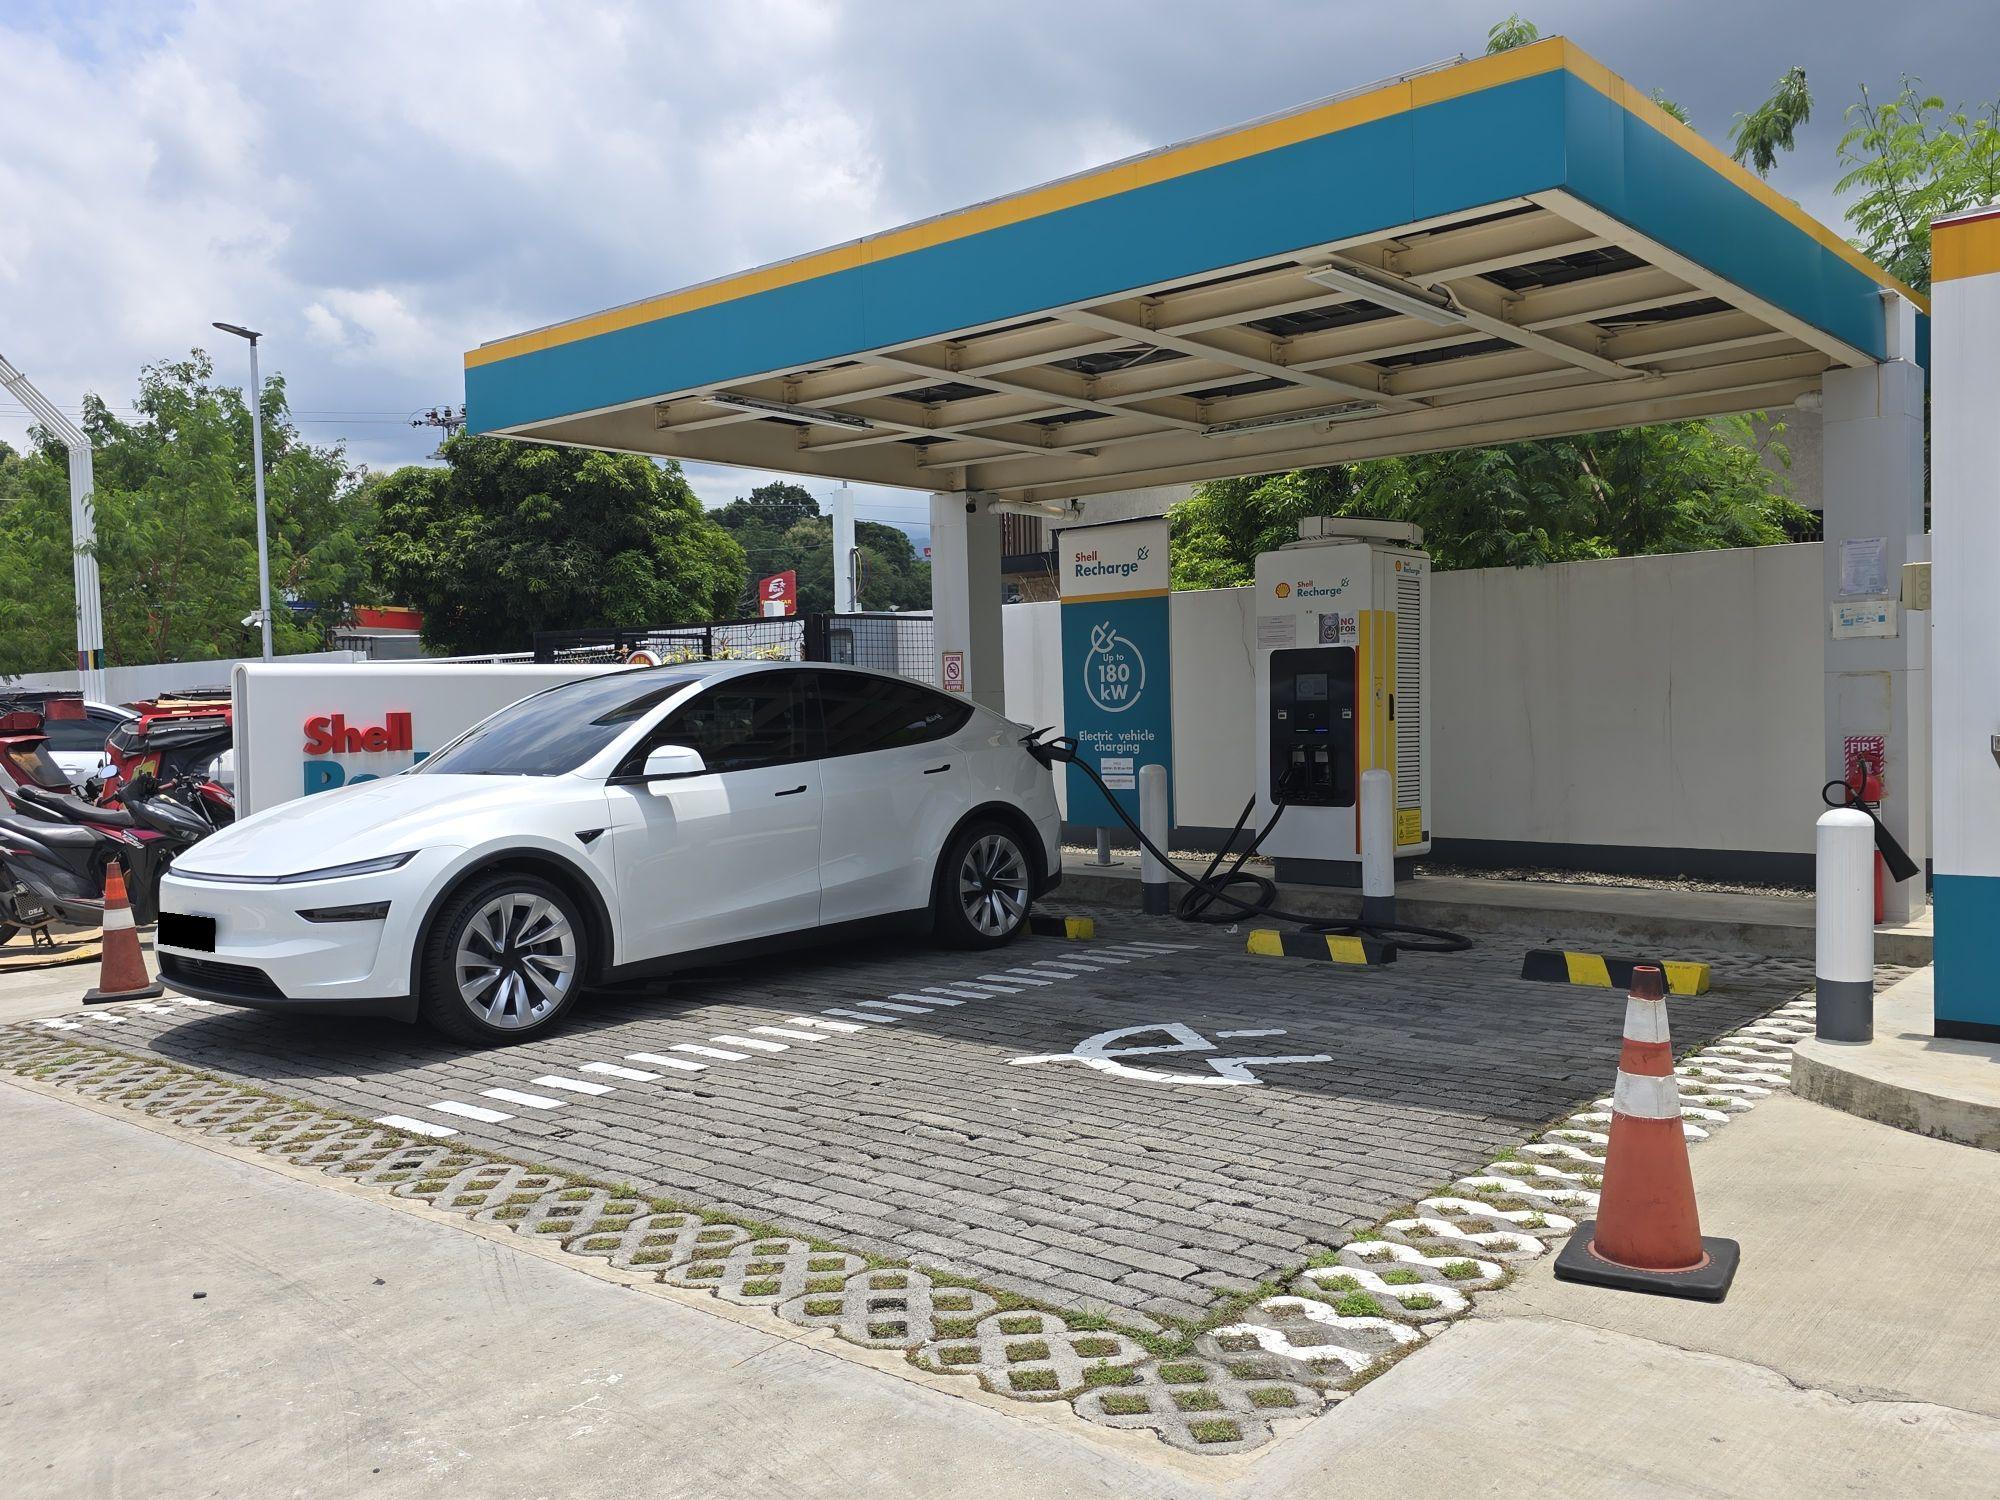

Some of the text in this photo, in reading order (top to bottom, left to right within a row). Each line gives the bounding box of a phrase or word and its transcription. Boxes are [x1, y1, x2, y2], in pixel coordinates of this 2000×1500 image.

[1075, 551, 1098, 562] Shell
[1075, 561, 1138, 577] Recharge
[1297, 580, 1313, 588] Shell
[1297, 587, 1342, 597] Recharge
[1340, 617, 1354, 625] NO
[1340, 625, 1356, 633] FOR
[1102, 653, 1124, 663] Up to
[1098, 663, 1130, 683] 180
[1100, 684, 1128, 700] kW
[303, 712, 413, 755] Shell
[1079, 729, 1155, 741] Electric vehicle
[1094, 741, 1140, 754] charging
[1850, 742, 1878, 754] FIRE
